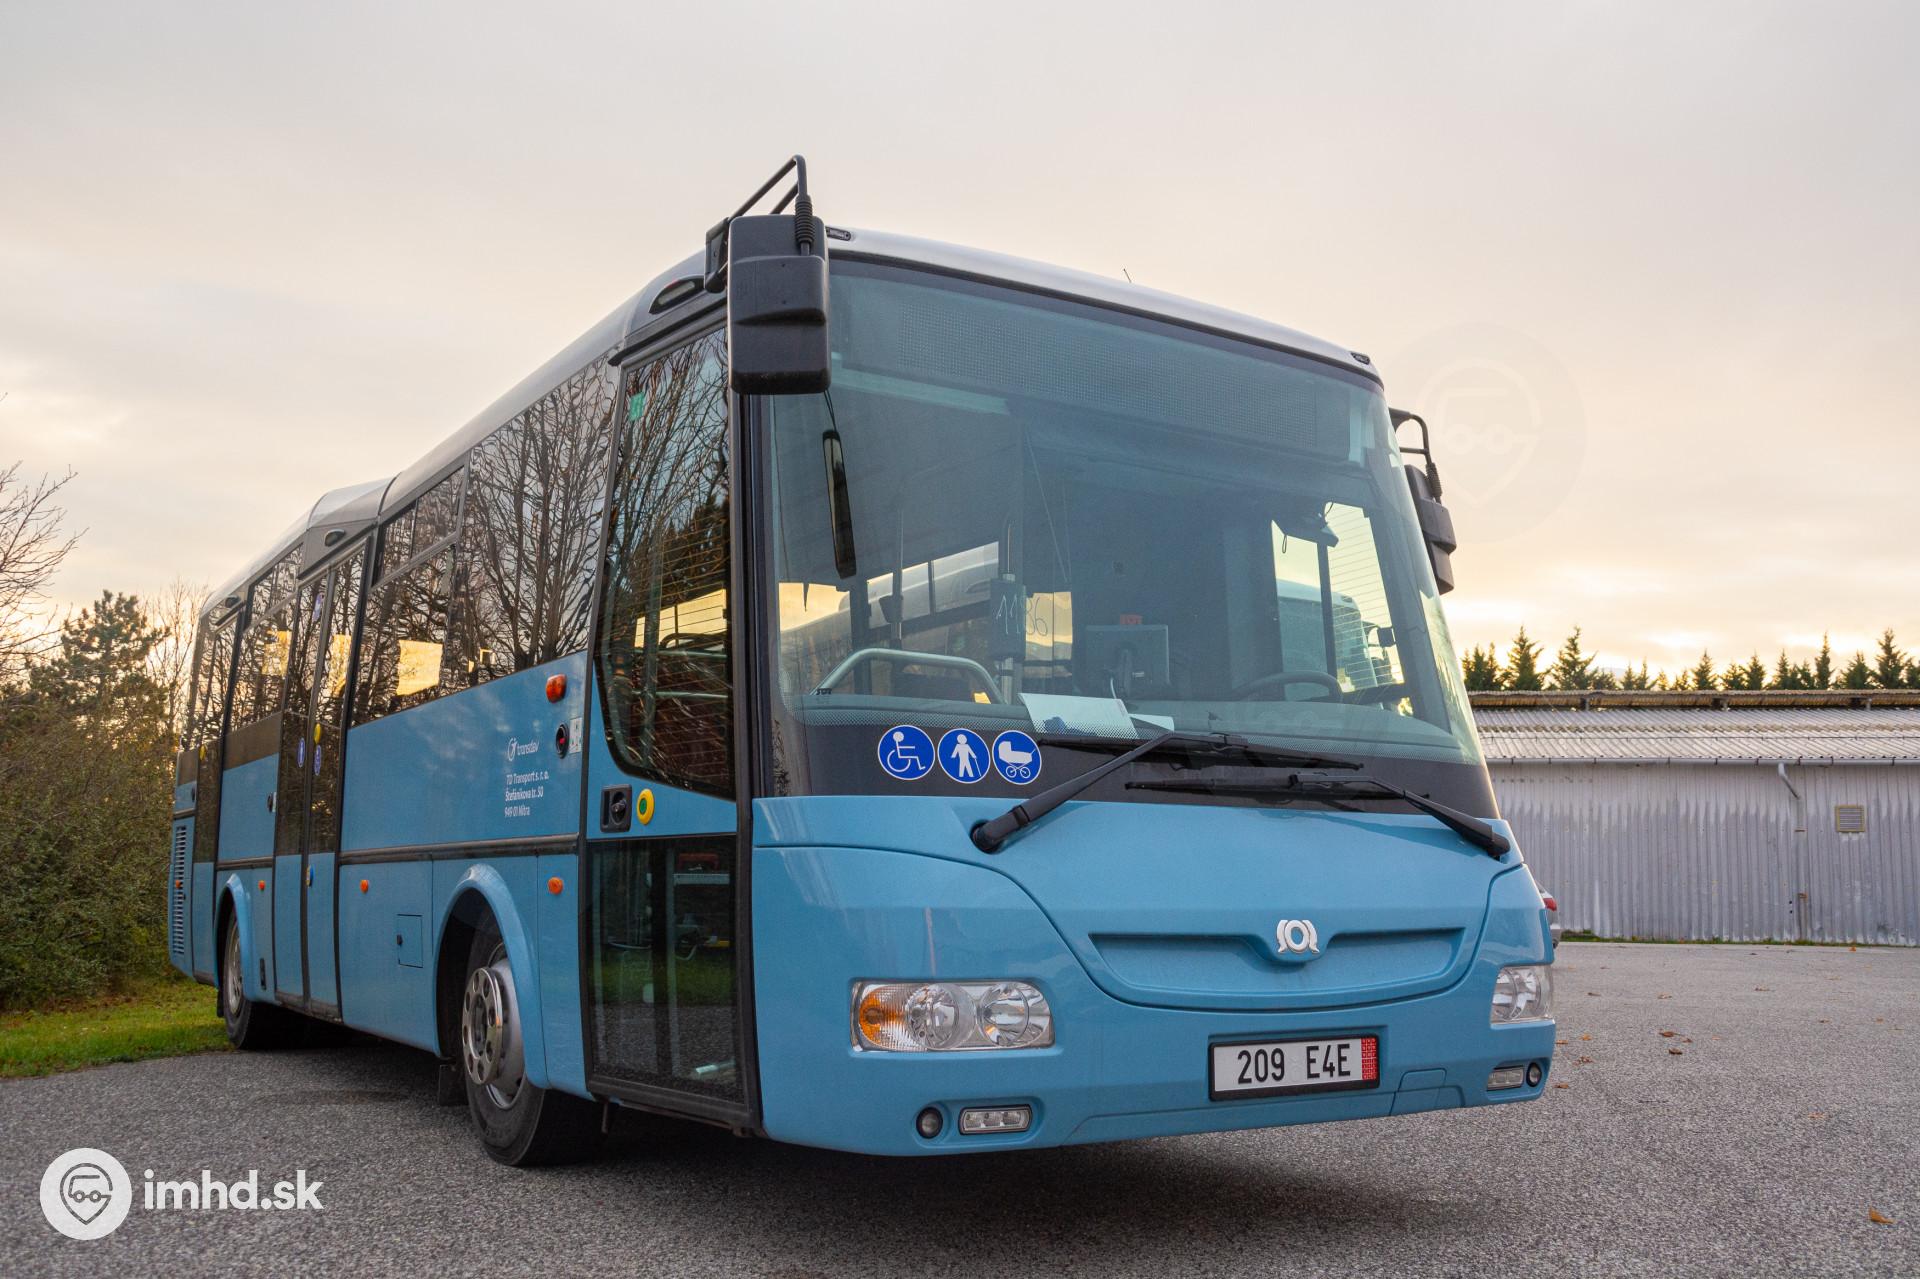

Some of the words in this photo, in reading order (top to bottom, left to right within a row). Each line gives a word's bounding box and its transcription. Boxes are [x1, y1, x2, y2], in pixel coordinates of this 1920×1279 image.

[513, 771, 535, 785] Transport
[519, 804, 531, 816] Nitra
[1237, 1048, 1285, 1084] 209
[1306, 1043, 1351, 1079] E4E
